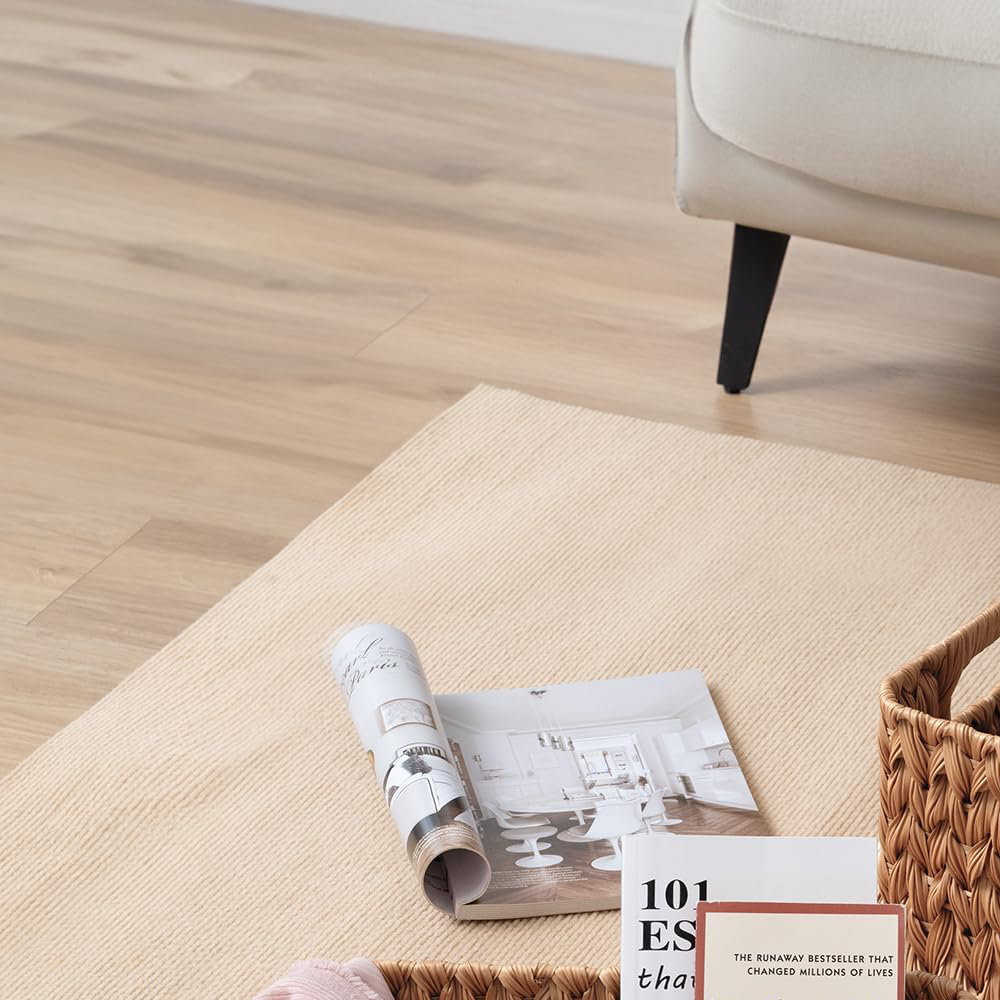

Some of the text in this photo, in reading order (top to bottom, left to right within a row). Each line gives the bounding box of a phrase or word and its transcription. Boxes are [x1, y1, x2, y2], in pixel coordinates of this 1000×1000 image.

[640, 879, 708, 910] 101
[734, 953, 894, 964] THE RUNAWAY BESTSELLER THAT
[747, 967, 894, 977] CHANGED MILLIONS OF LIVES
